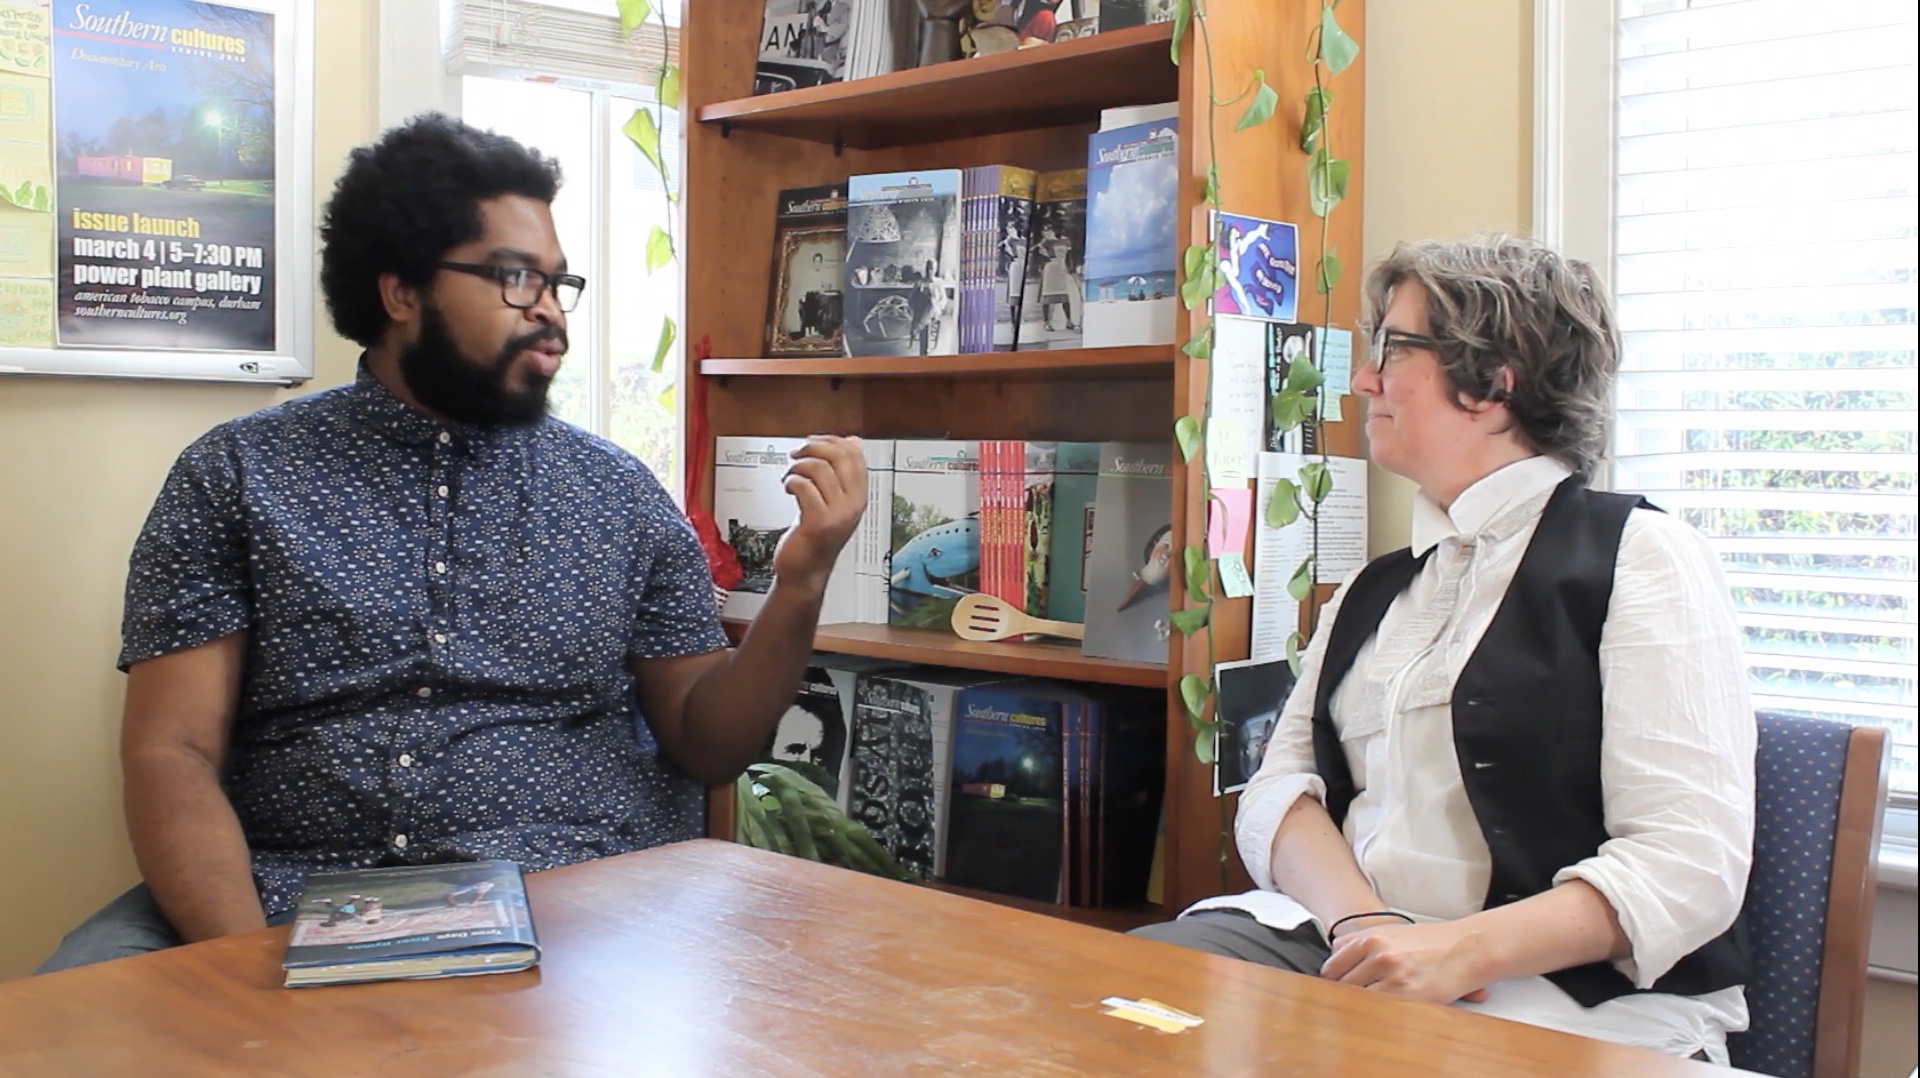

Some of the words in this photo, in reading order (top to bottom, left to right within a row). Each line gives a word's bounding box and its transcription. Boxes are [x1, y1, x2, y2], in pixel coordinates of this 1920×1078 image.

[69, 3, 168, 42] Southern
[170, 28, 246, 54] cultures
[70, 47, 140, 71] Documentary
[143, 60, 167, 72] Arts
[72, 208, 129, 233] issue
[133, 213, 200, 238] launch
[73, 237, 140, 260] march
[142, 240, 156, 262] 4
[235, 247, 263, 269] PM
[73, 264, 139, 286] power
[141, 266, 192, 289] plant
[195, 269, 262, 295] gallery
[74, 289, 127, 304] american
[130, 291, 170, 305] tobacco
[172, 297, 216, 311] campus,
[218, 295, 262, 310] durham
[73, 303, 188, 325] southerncultures.org
[1110, 456, 1165, 475] Southern
[964, 703, 1008, 722] Southern
